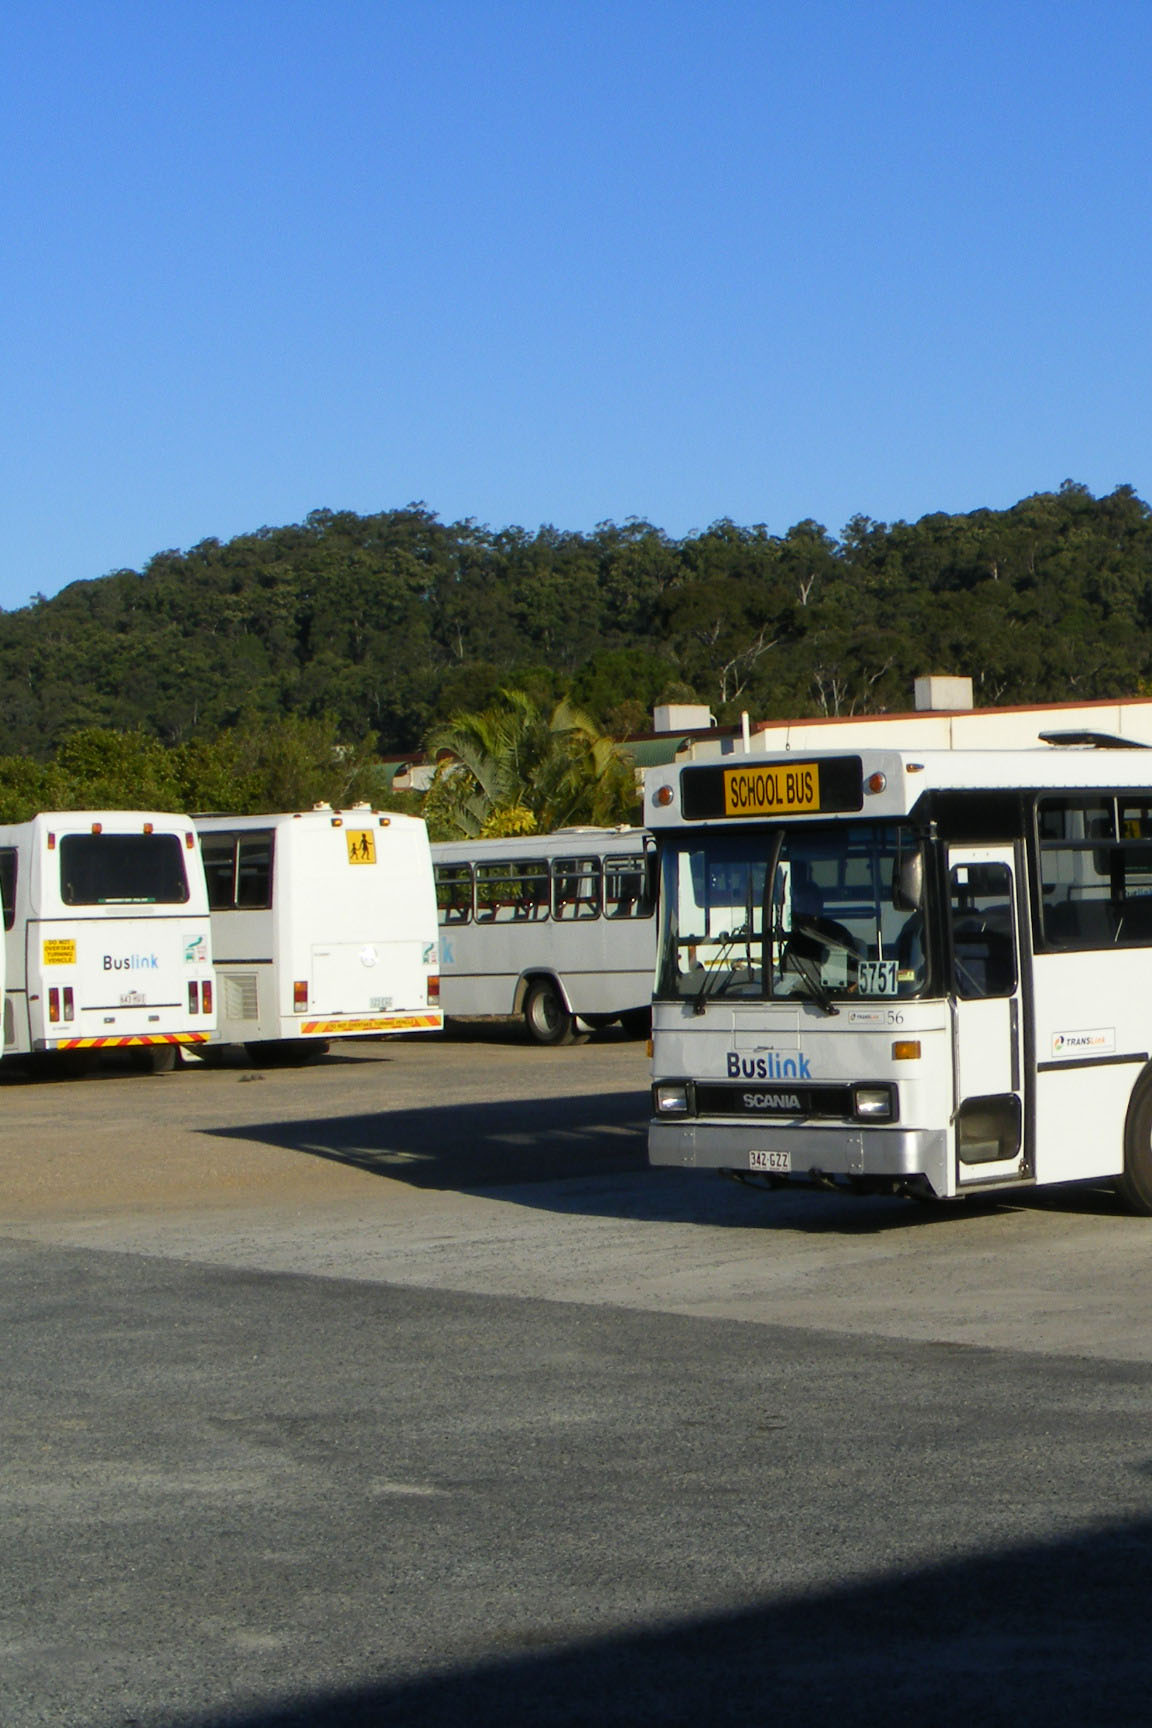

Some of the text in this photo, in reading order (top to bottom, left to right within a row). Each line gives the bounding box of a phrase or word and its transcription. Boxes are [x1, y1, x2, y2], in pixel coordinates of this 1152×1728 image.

[731, 771, 813, 808] SCHOOL BUS
[103, 954, 159, 971] Buslink
[859, 962, 896, 993] 5751
[887, 1010, 904, 1025] 56
[727, 1052, 812, 1079] Buslink
[743, 1094, 801, 1108] SCANIA
